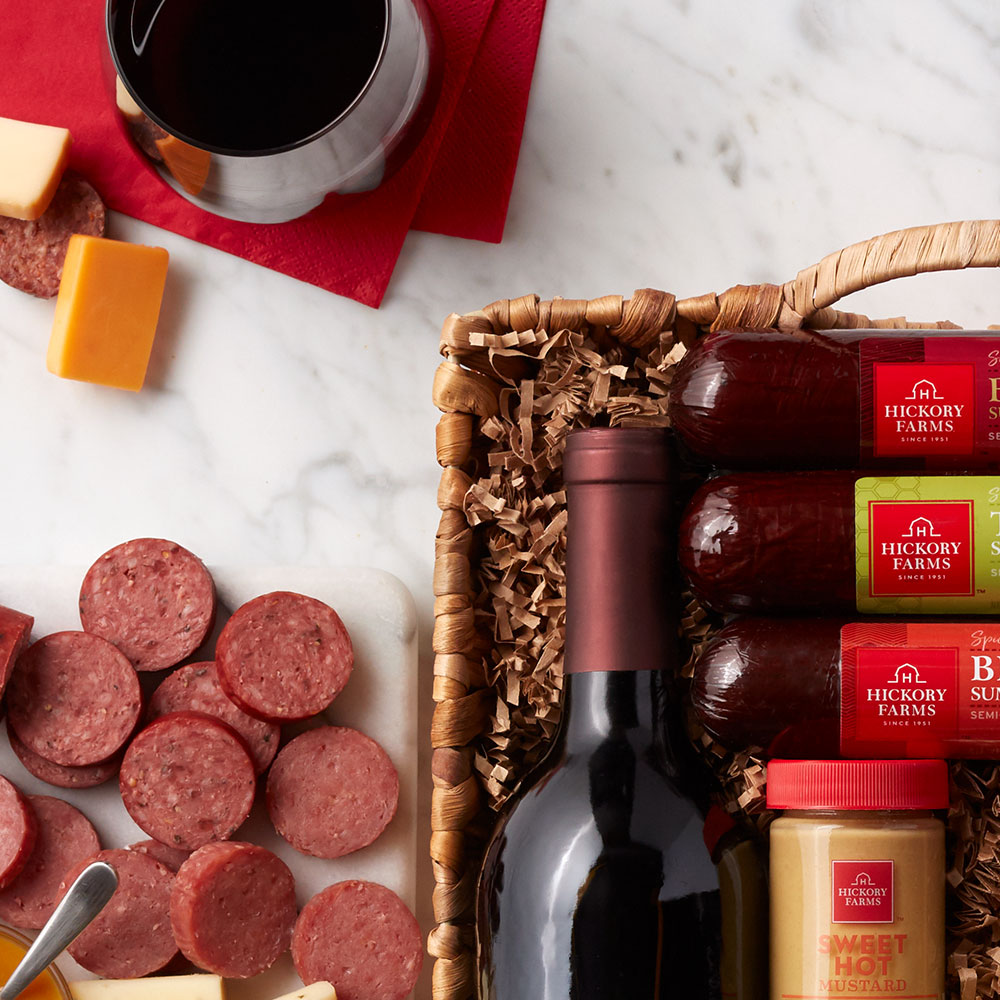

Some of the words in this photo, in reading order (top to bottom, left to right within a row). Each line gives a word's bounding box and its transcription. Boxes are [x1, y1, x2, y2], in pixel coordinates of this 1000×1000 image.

[885, 405, 964, 418] HICKORY
[896, 420, 954, 433] FARMS
[881, 542, 961, 555] HICKORY
[893, 558, 951, 570] FARMS
[866, 688, 947, 702] HICKORY
[878, 704, 936, 716] FARMS
[838, 888, 887, 897] HICKORY
[845, 898, 881, 906] FARMS
[818, 934, 908, 954] SWEET
[835, 956, 892, 976] HOT
[819, 980, 907, 992] MUSTARD
